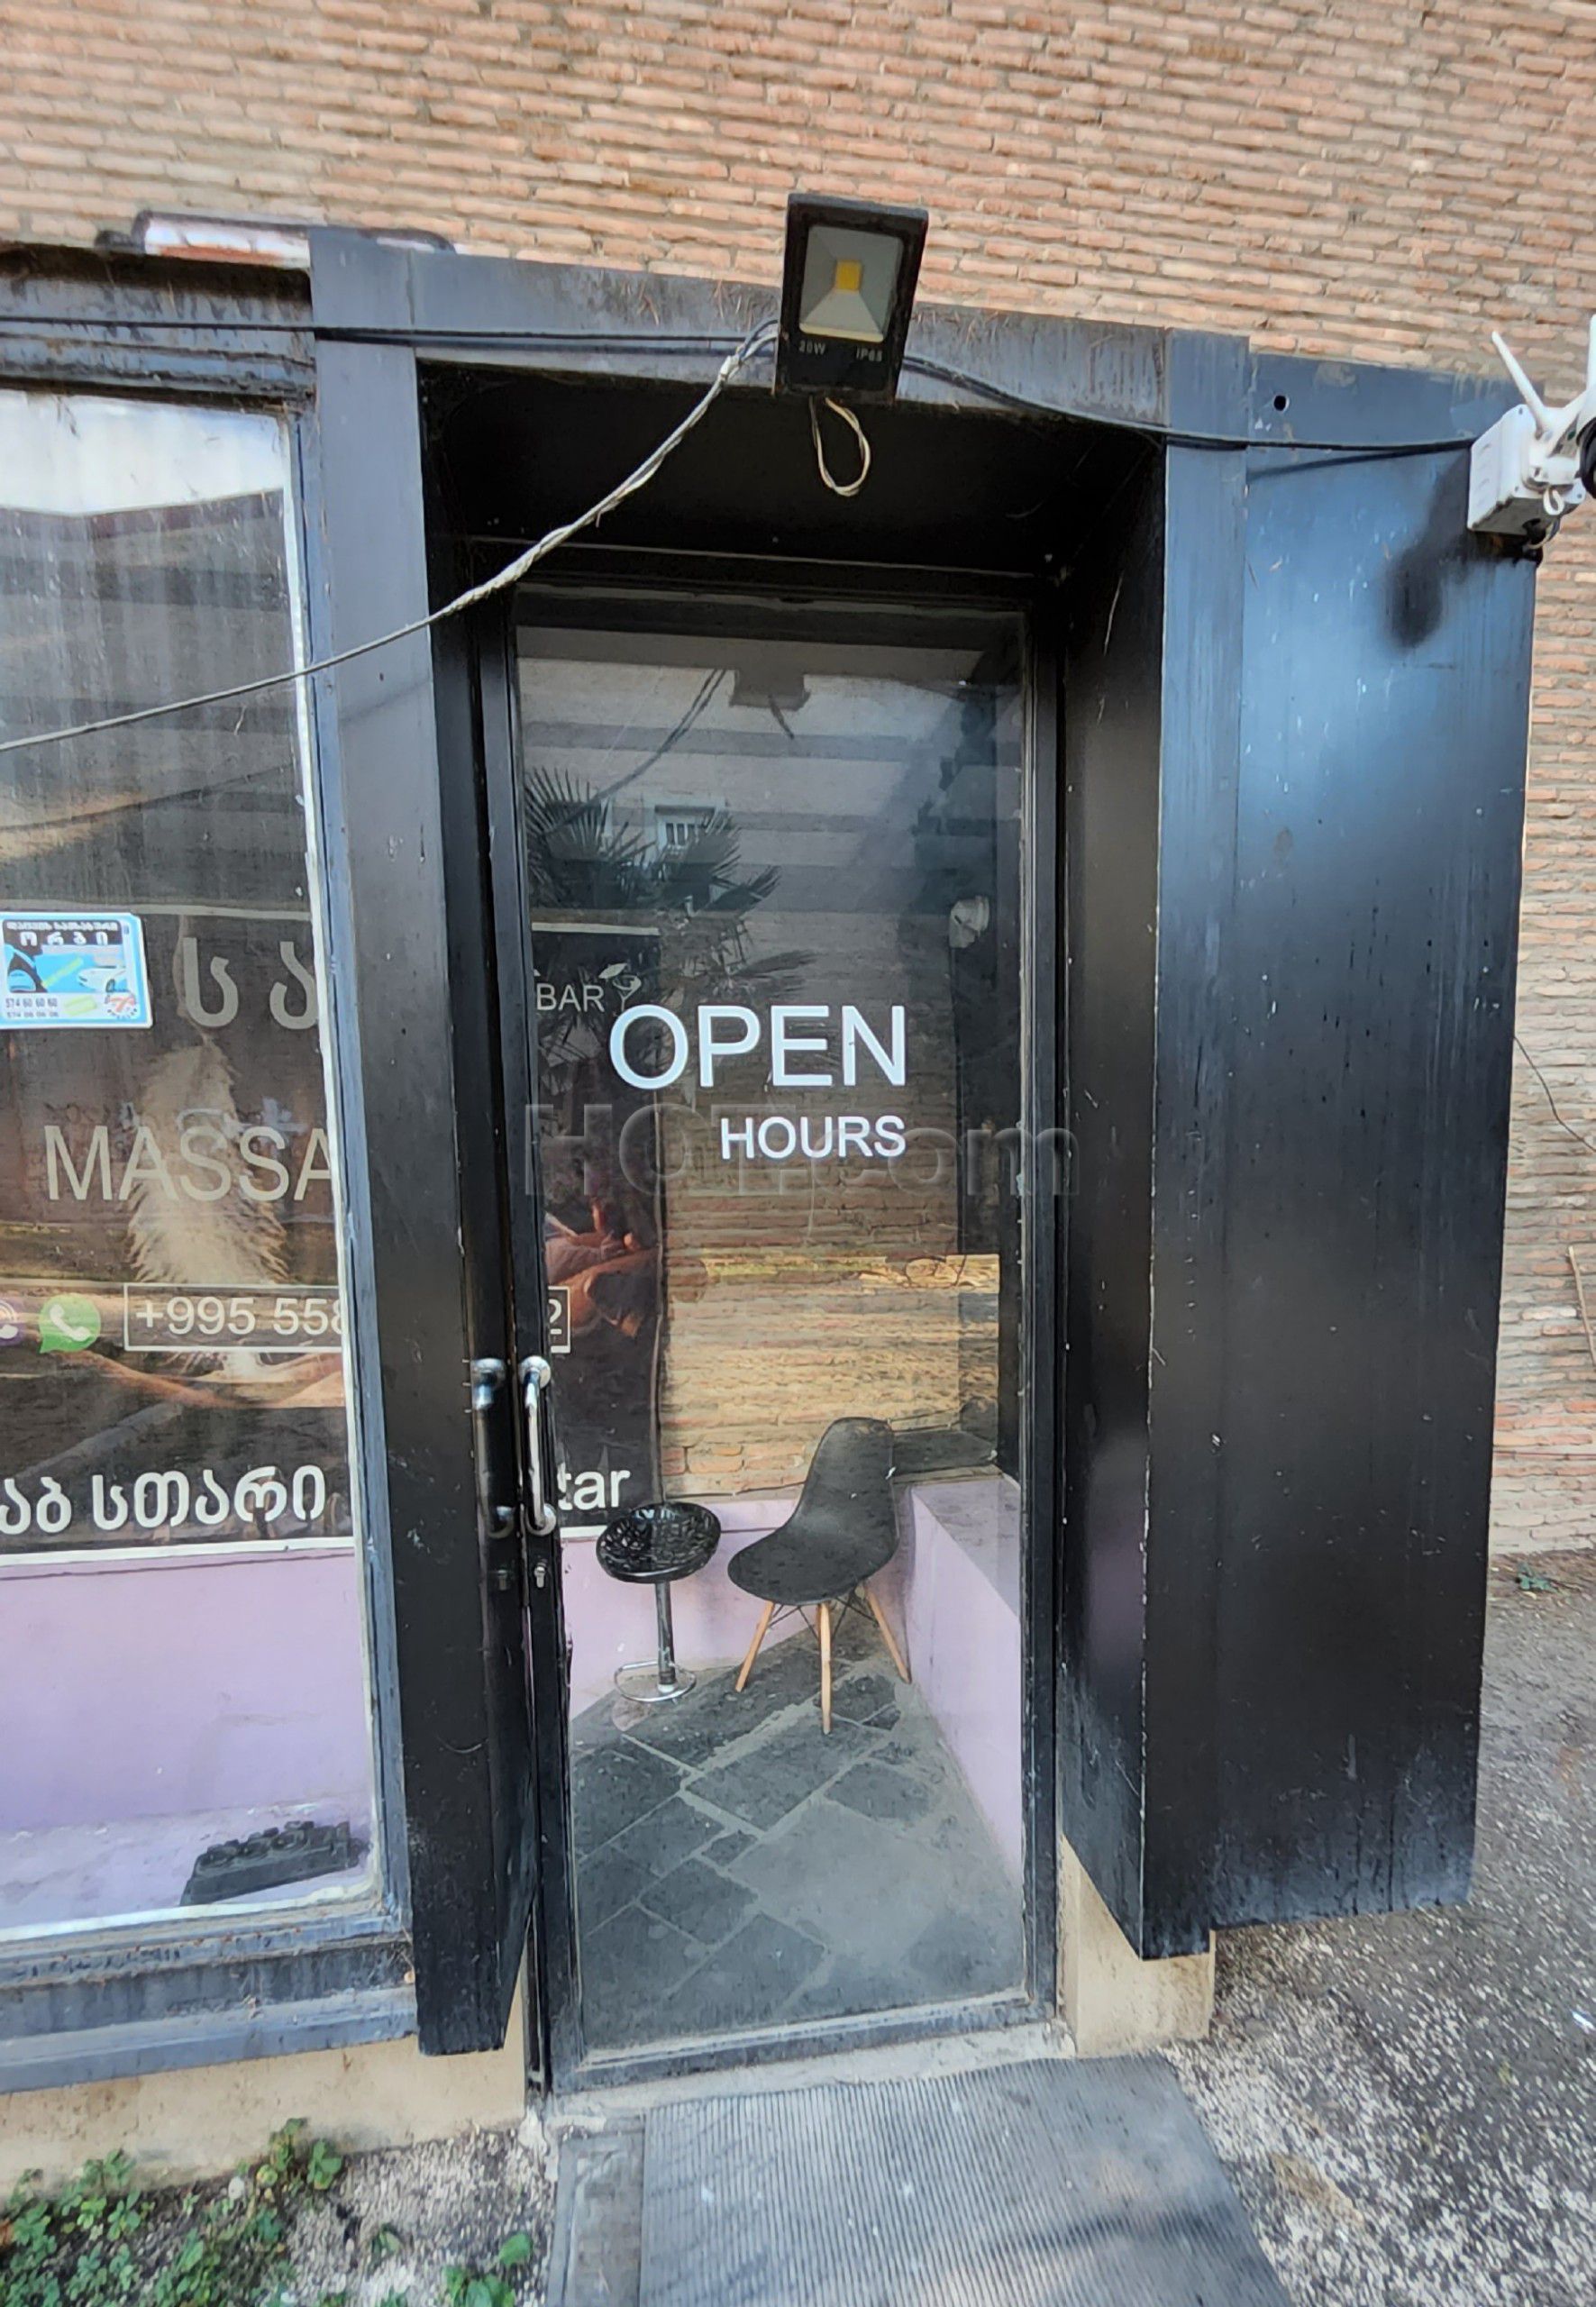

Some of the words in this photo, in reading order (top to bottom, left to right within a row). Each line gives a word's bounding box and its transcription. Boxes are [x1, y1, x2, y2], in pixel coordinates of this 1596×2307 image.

[536, 982, 605, 1012] BAR
[609, 1004, 906, 1090] OPEN
[43, 1125, 333, 1201] MASSA
[720, 1115, 907, 1160] HOURS
[136, 1296, 256, 1336] +995
[92, 1464, 325, 1531] სთარი
